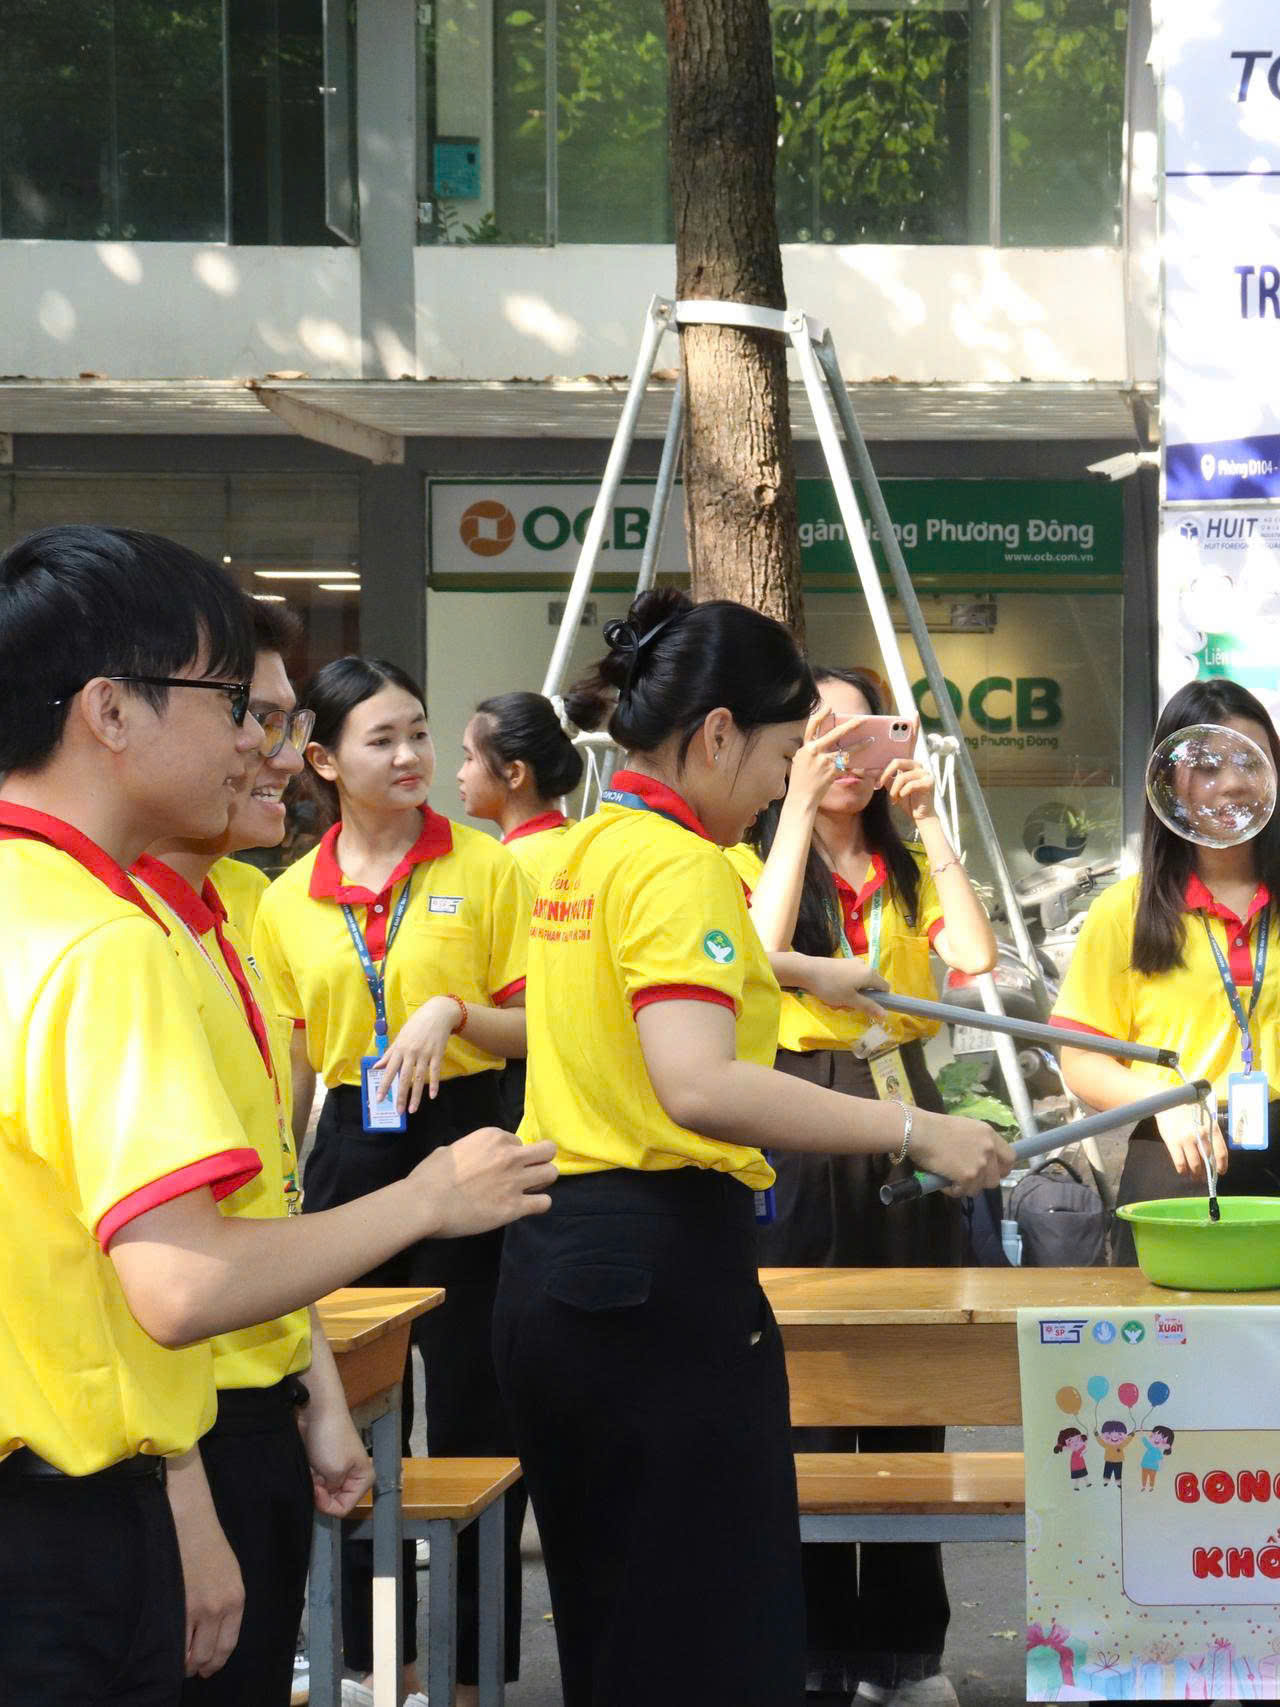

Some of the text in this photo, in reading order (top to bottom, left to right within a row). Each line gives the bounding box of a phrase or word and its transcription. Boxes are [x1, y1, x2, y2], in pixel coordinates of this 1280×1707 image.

[522, 505, 650, 551] OCB
[798, 518, 845, 548] gân
[926, 518, 1020, 549] Phương
[1026, 518, 1095, 549] Đông
[1206, 517, 1259, 538] HUIT
[1004, 552, 1095, 562] www.ocb.com.vn
[911, 676, 1062, 734] OCB
[963, 734, 1059, 750] ng Phương Đông
